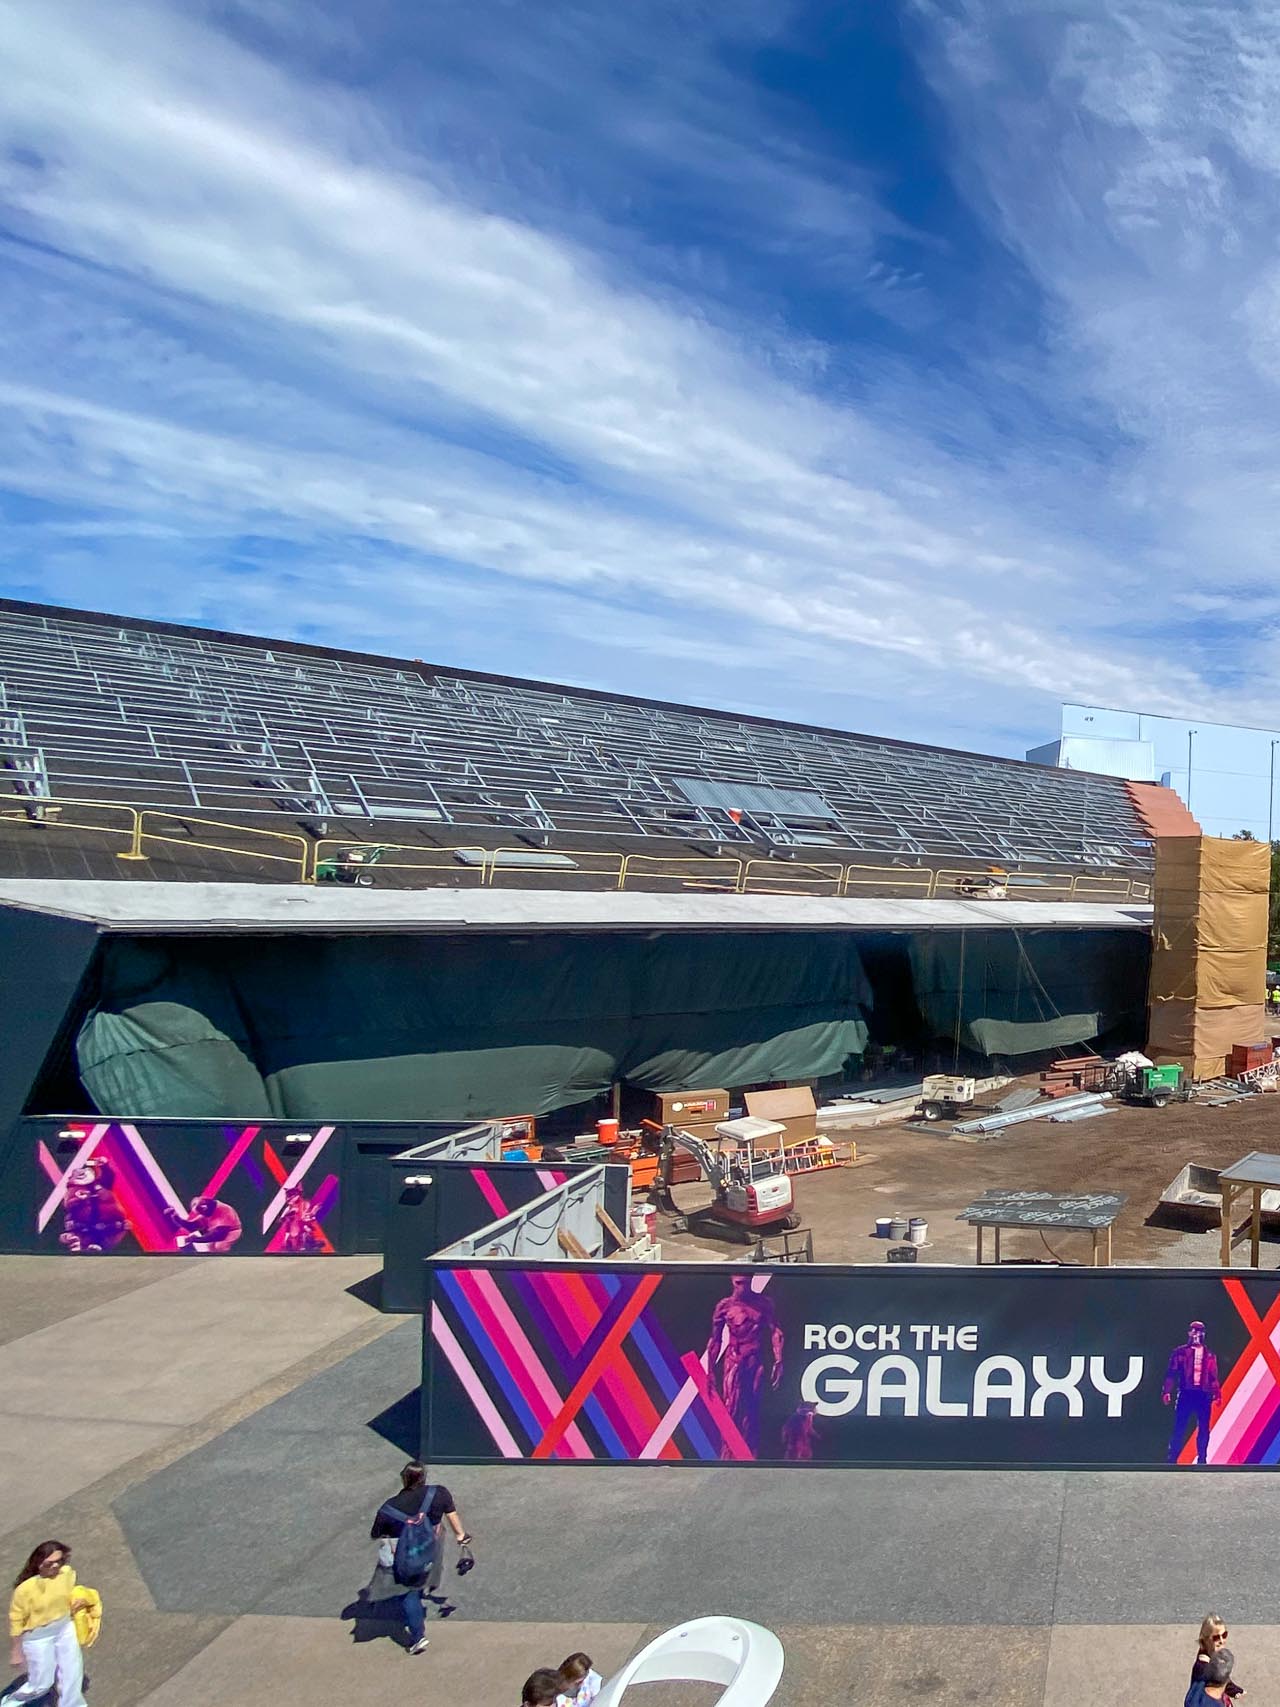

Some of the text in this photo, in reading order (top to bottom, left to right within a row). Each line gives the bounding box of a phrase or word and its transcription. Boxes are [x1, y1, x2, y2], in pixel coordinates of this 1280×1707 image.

[803, 1324, 978, 1351] ROCK THE
[800, 1354, 1144, 1417] GALAXY
